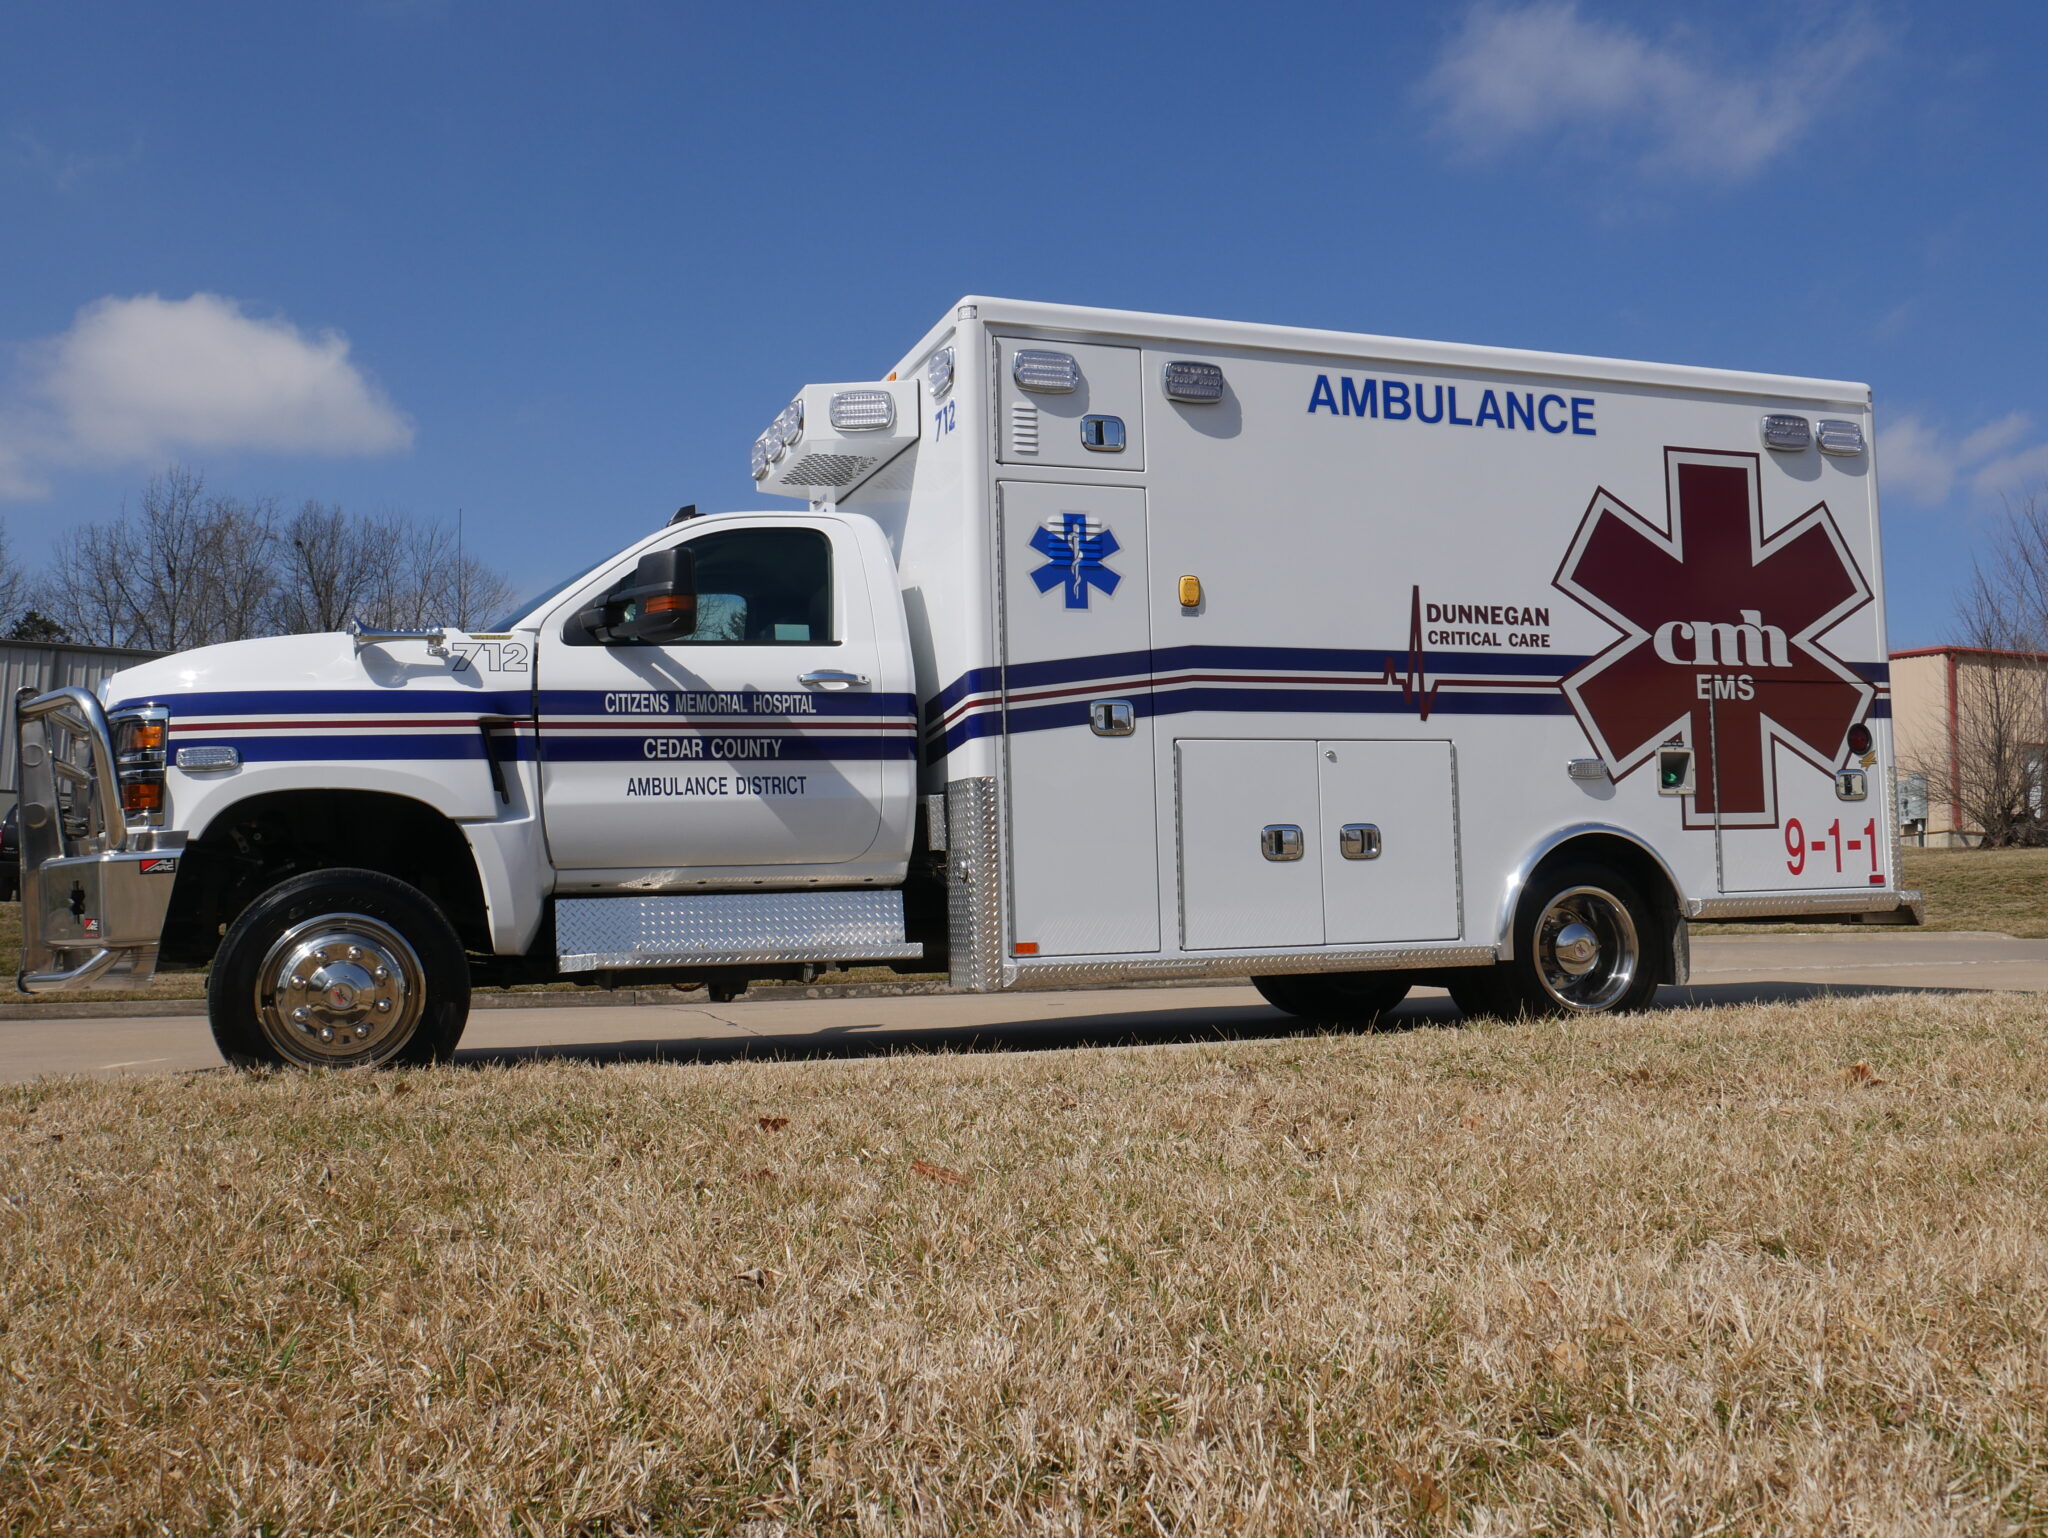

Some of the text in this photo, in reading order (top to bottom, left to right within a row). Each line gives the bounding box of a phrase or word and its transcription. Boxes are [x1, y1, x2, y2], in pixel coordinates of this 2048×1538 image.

[1307, 374, 1597, 436] AMBULANCE
[935, 400, 955, 443] 712
[1426, 604, 1550, 627] DUNNEGAN
[1428, 630, 1550, 648] CRITICAL CARE
[1653, 609, 1793, 667] cmh
[452, 642, 528, 672] 712
[1696, 674, 1755, 700] EMS
[605, 693, 816, 714] CITIZENS MEMORIAL HOSPITAL
[643, 738, 782, 759] CEDAR COUNTY
[626, 775, 807, 796] AMBULANCE DISTRICT
[1784, 817, 1878, 875] 9-1-1
